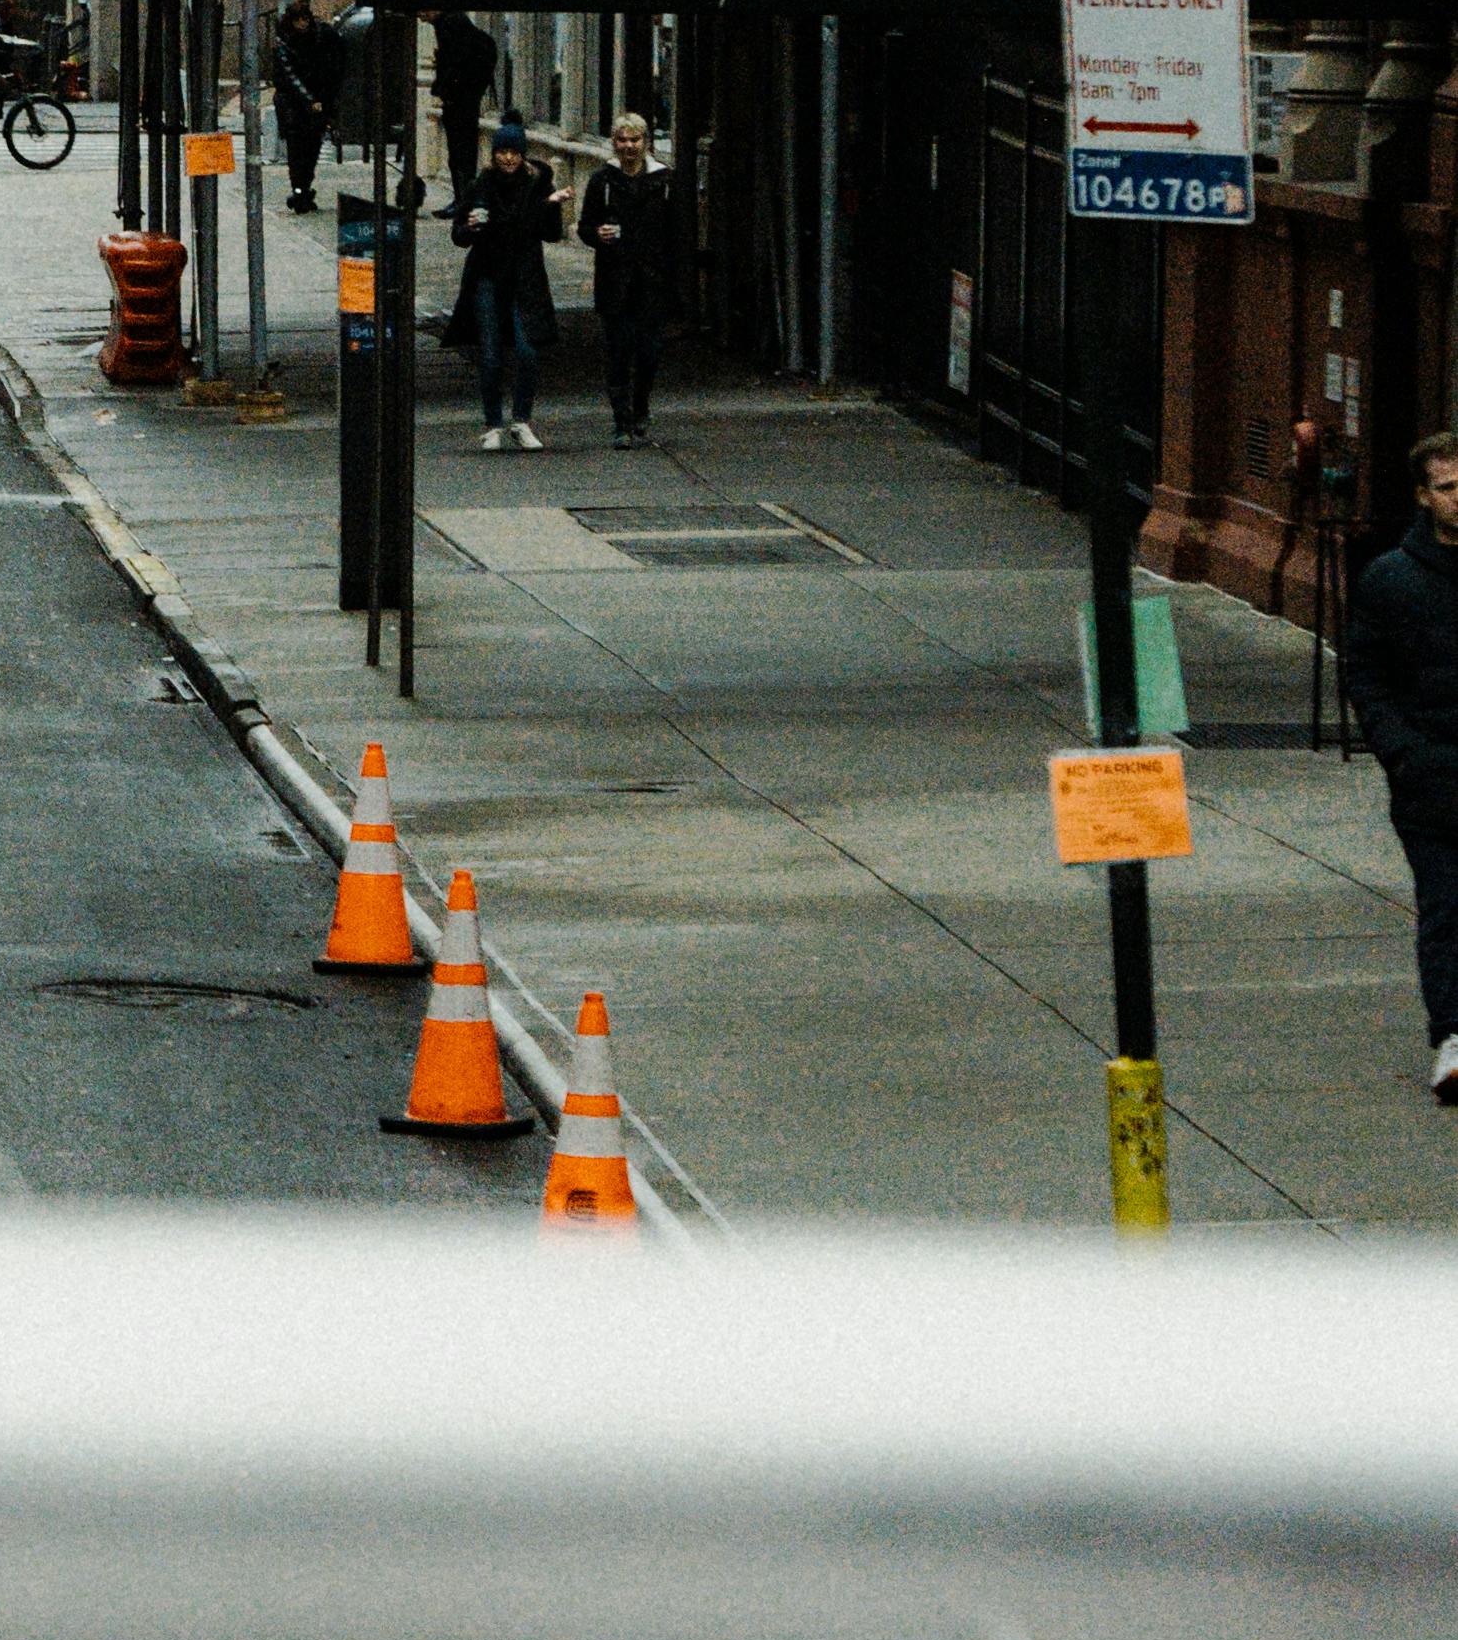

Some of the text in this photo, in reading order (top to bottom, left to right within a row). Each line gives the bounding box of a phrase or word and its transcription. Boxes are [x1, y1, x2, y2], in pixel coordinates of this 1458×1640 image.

[1079, 54, 1140, 77] Monday
[1155, 55, 1205, 80] Friday
[1081, 80, 1115, 100] 8am
[1128, 81, 1162, 105] 7pm
[1091, 759, 1164, 774] PARKING
